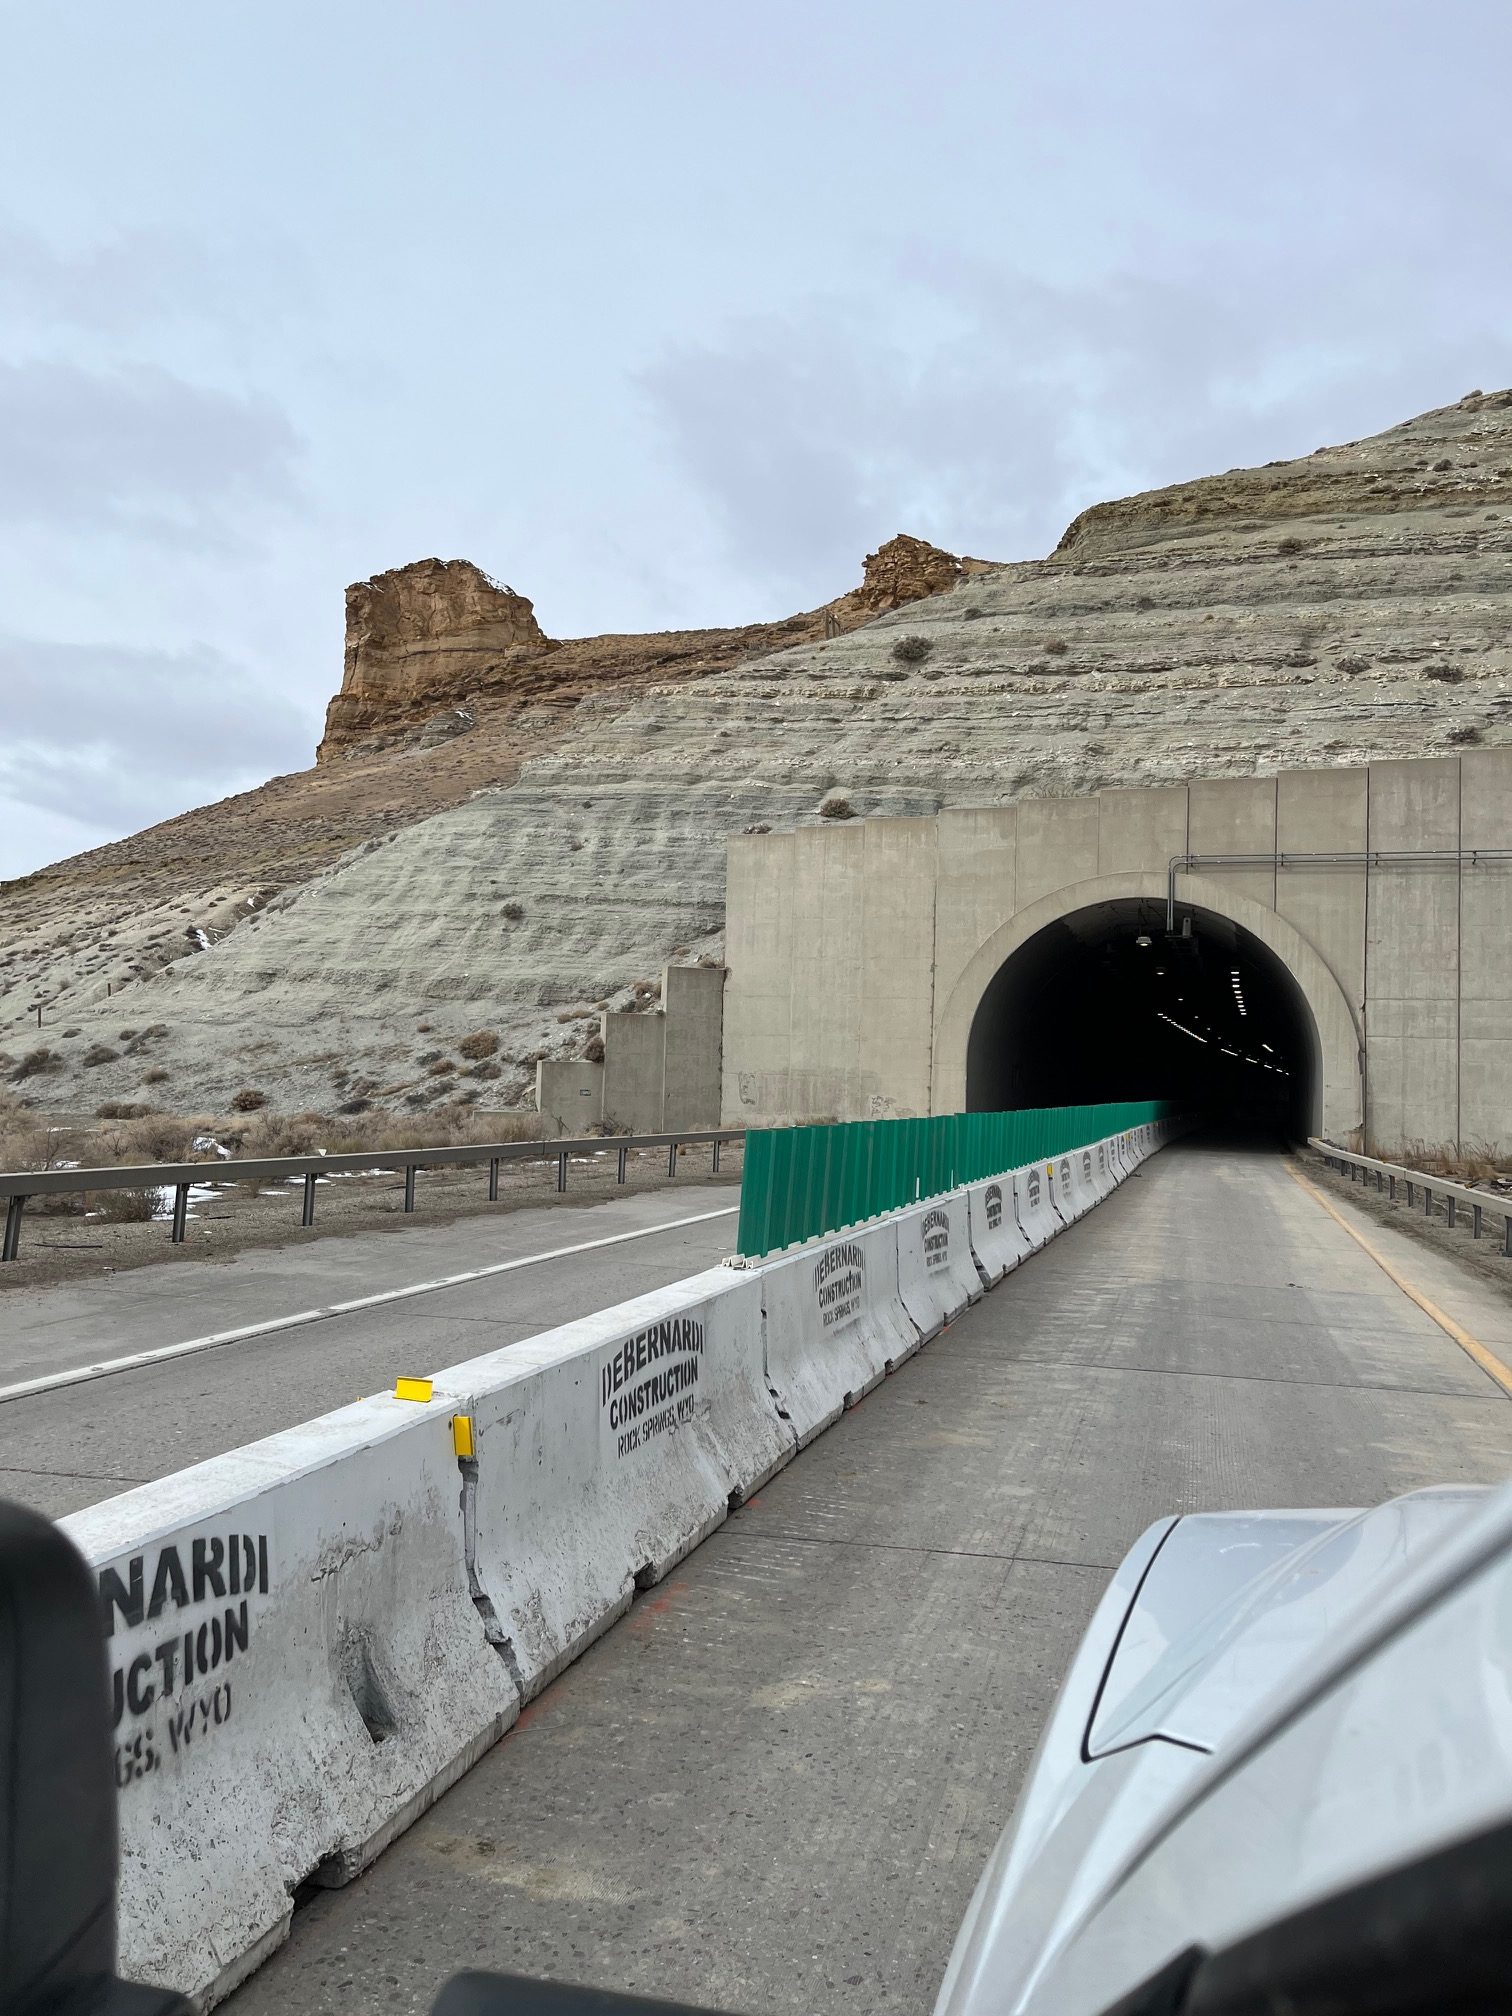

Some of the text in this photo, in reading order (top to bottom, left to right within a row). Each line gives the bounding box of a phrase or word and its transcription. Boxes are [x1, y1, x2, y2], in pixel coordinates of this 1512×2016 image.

[814, 1244, 863, 1292] DEBERNARDI
[602, 1318, 703, 1407] DEBERNARDI
[610, 1355, 698, 1430] CONSTRUCTION
[618, 1425, 641, 1459] ROCK
[677, 1394, 694, 1421] WYO
[169, 1683, 232, 1753] WYO
